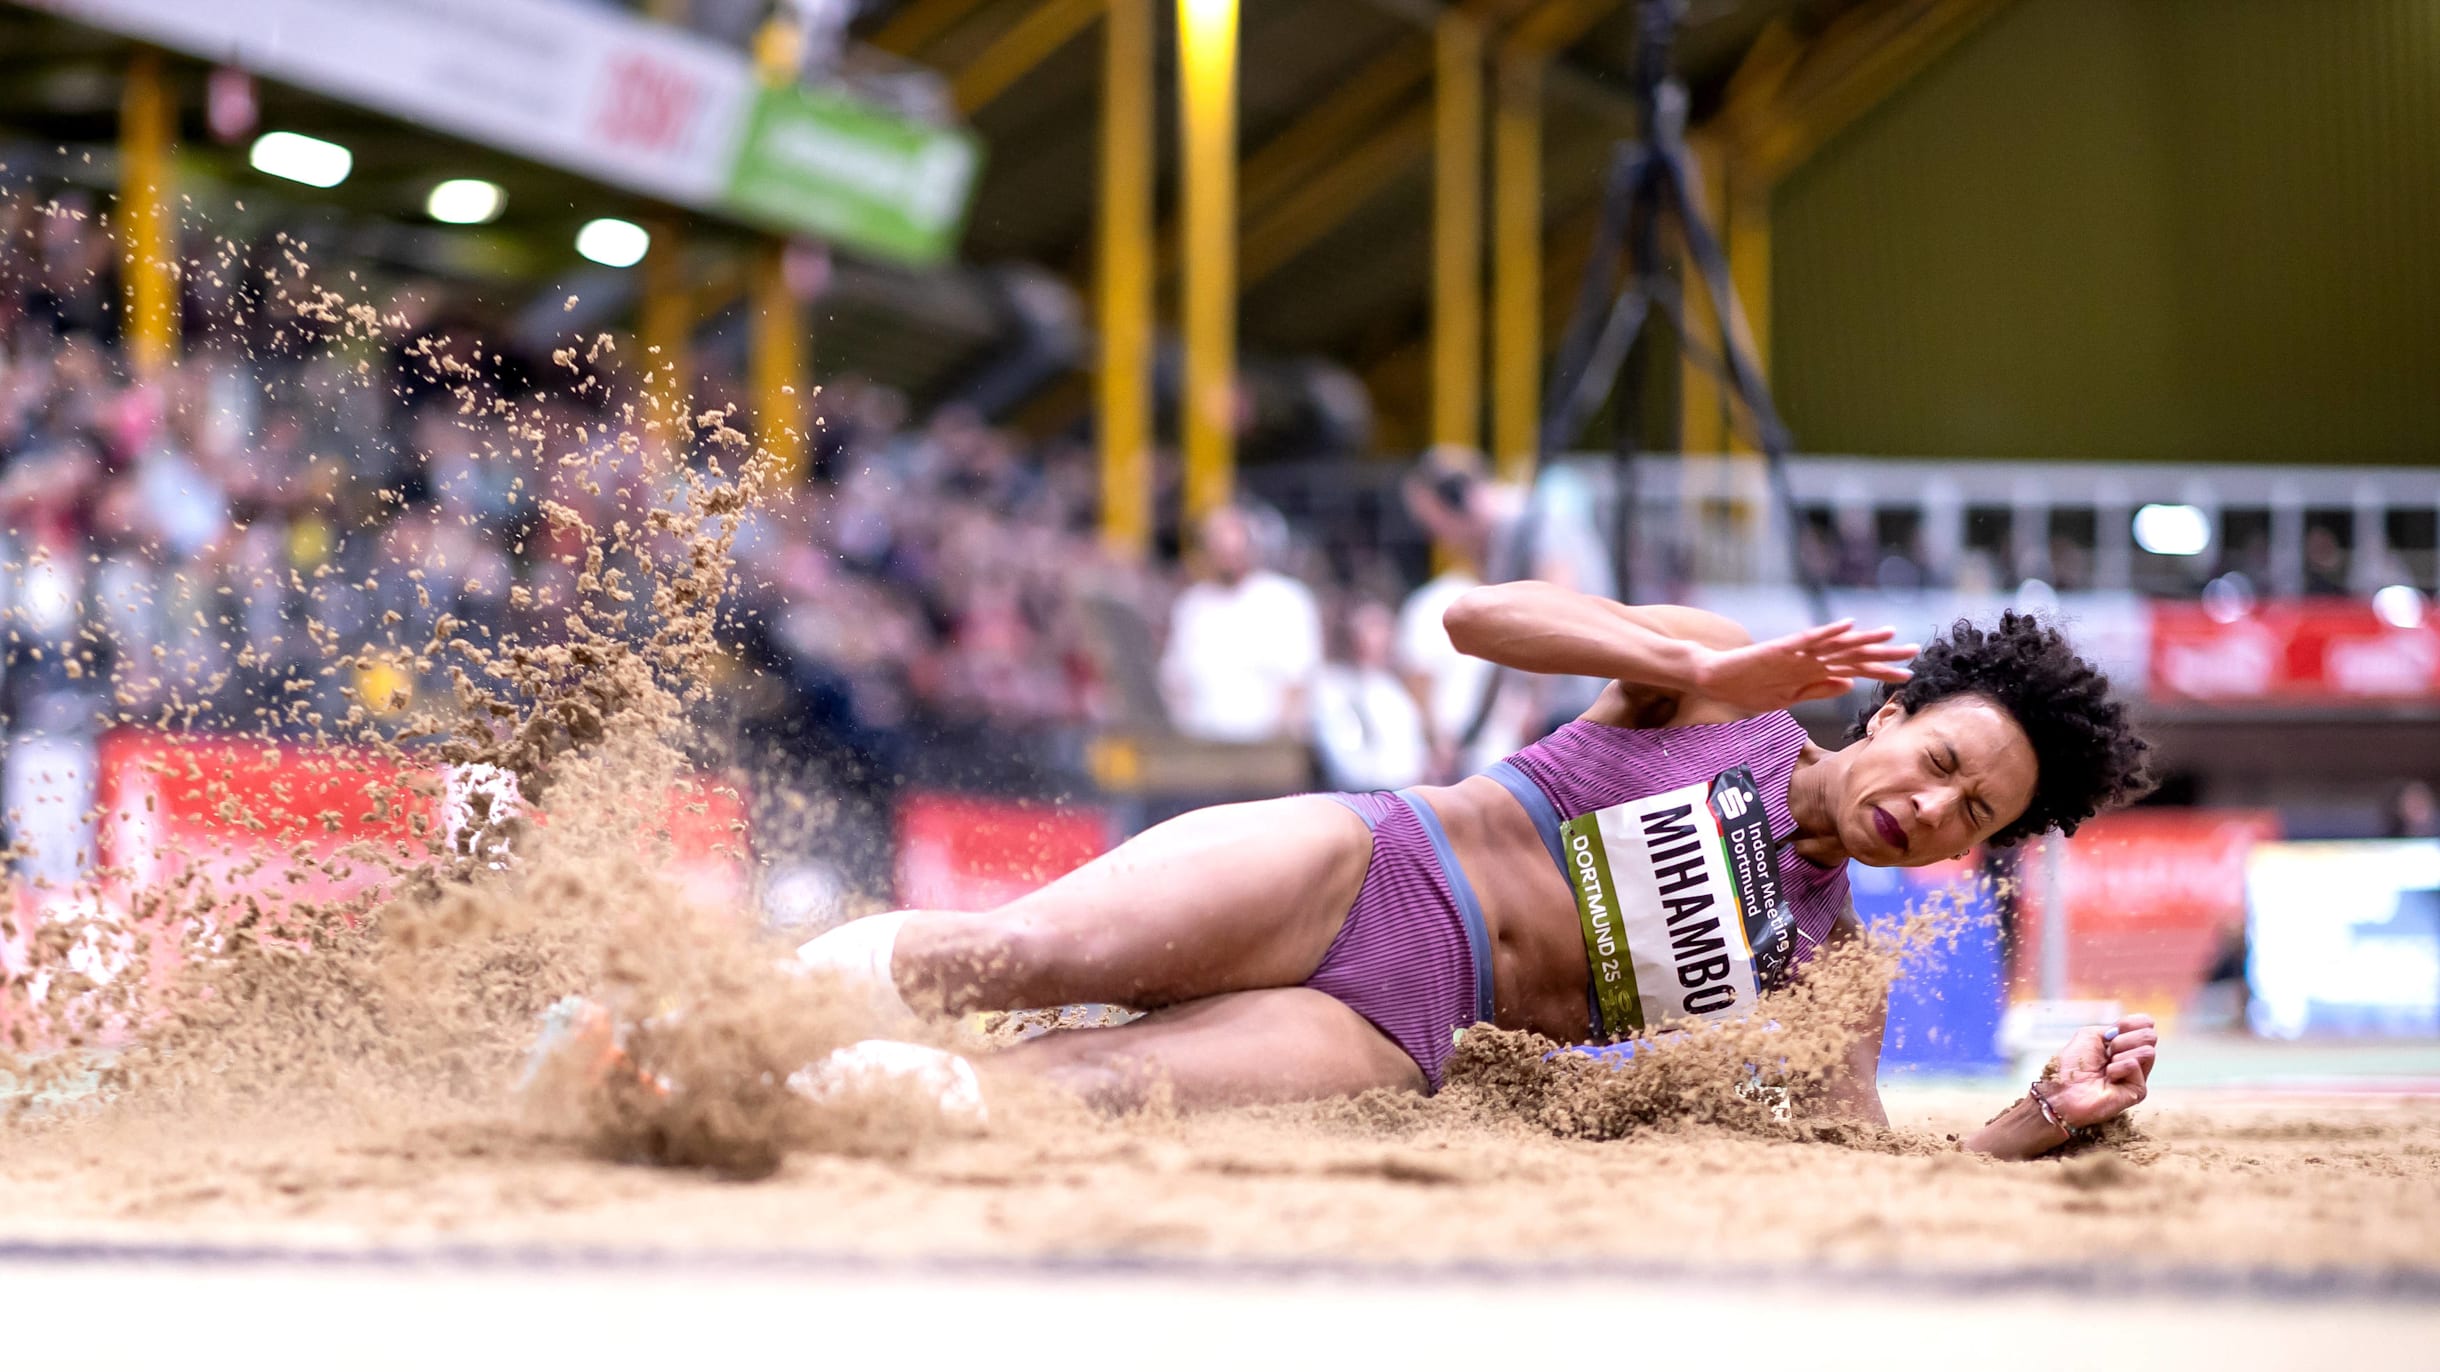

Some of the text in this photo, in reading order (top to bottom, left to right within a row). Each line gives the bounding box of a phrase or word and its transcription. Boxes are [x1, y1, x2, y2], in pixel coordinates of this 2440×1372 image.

[1572, 835, 1621, 983] DORTMUND 25
[1640, 803, 1737, 1015] MIHAMBO
[1730, 828, 1761, 917] Dortmund
[1748, 821, 1790, 952] Indoor Meeting
